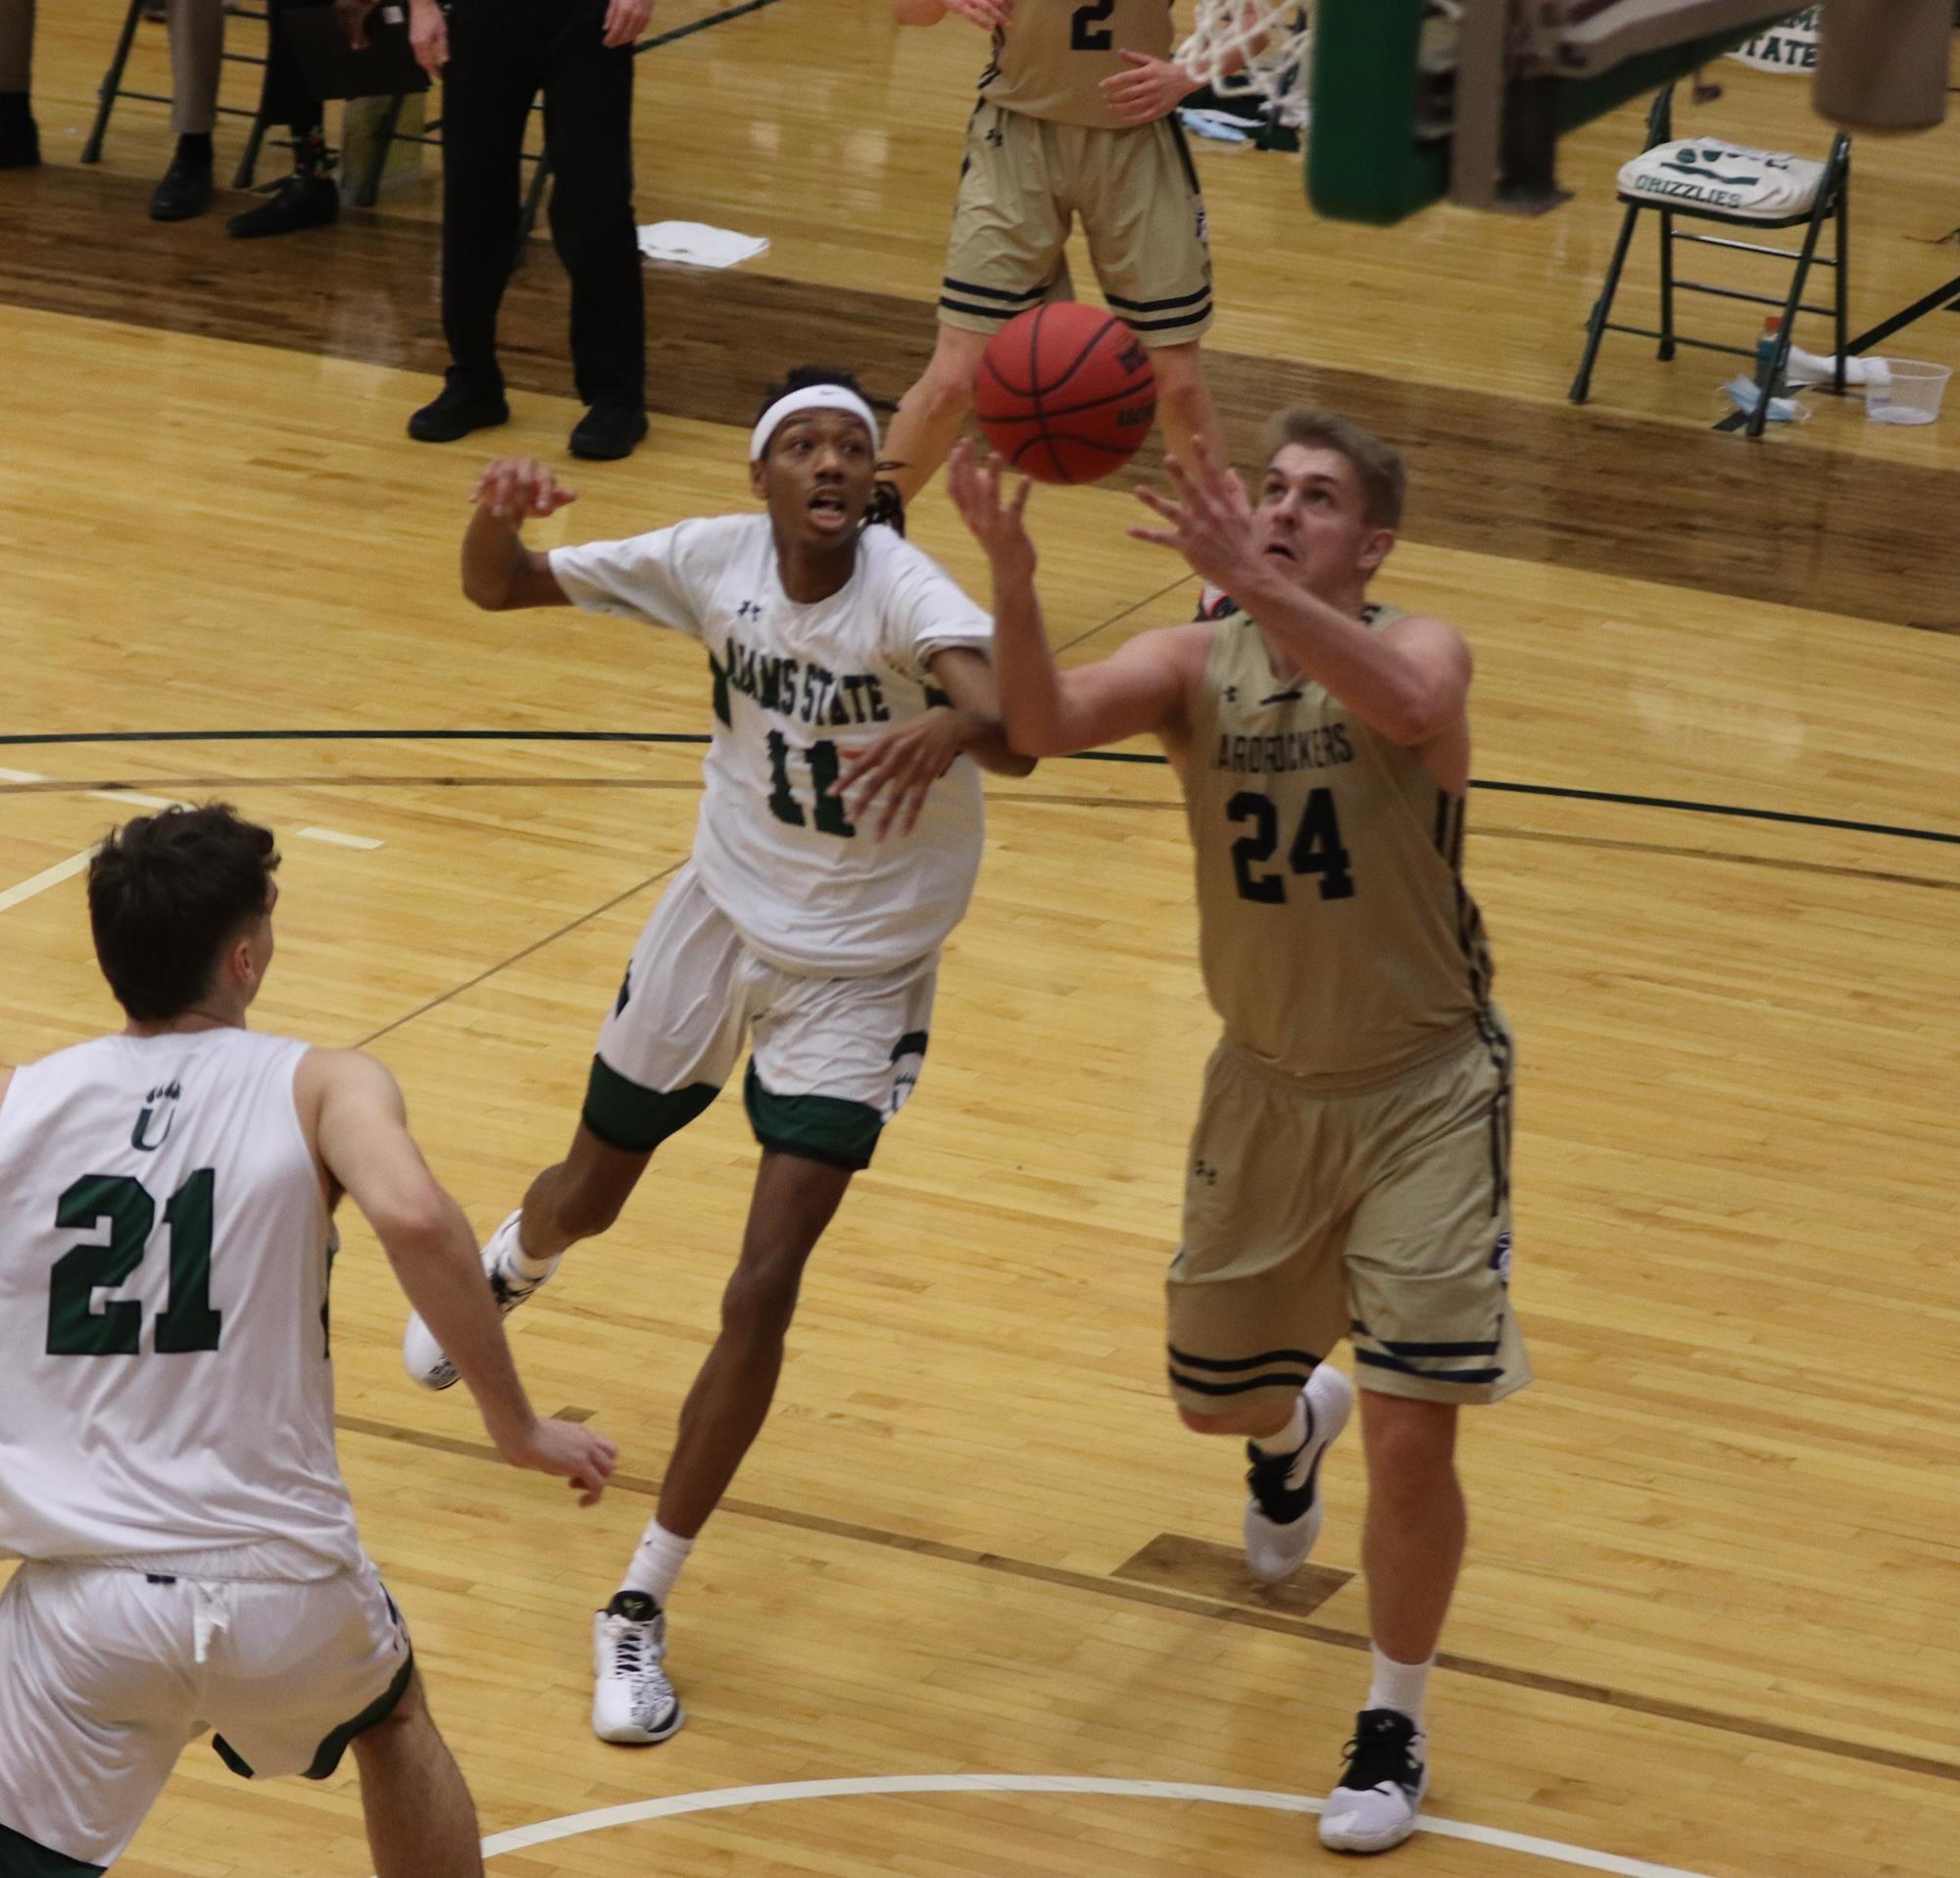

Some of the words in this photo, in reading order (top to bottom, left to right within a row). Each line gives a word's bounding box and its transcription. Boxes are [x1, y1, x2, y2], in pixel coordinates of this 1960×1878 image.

[1070, 0, 1113, 50] 2
[1745, 36, 1820, 68] TATE
[1635, 174, 1741, 209] GRIZZLIES
[801, 663, 891, 726] STATE
[767, 728, 857, 838] 11
[1226, 787, 1356, 904] 24
[45, 1167, 222, 1357] 21
